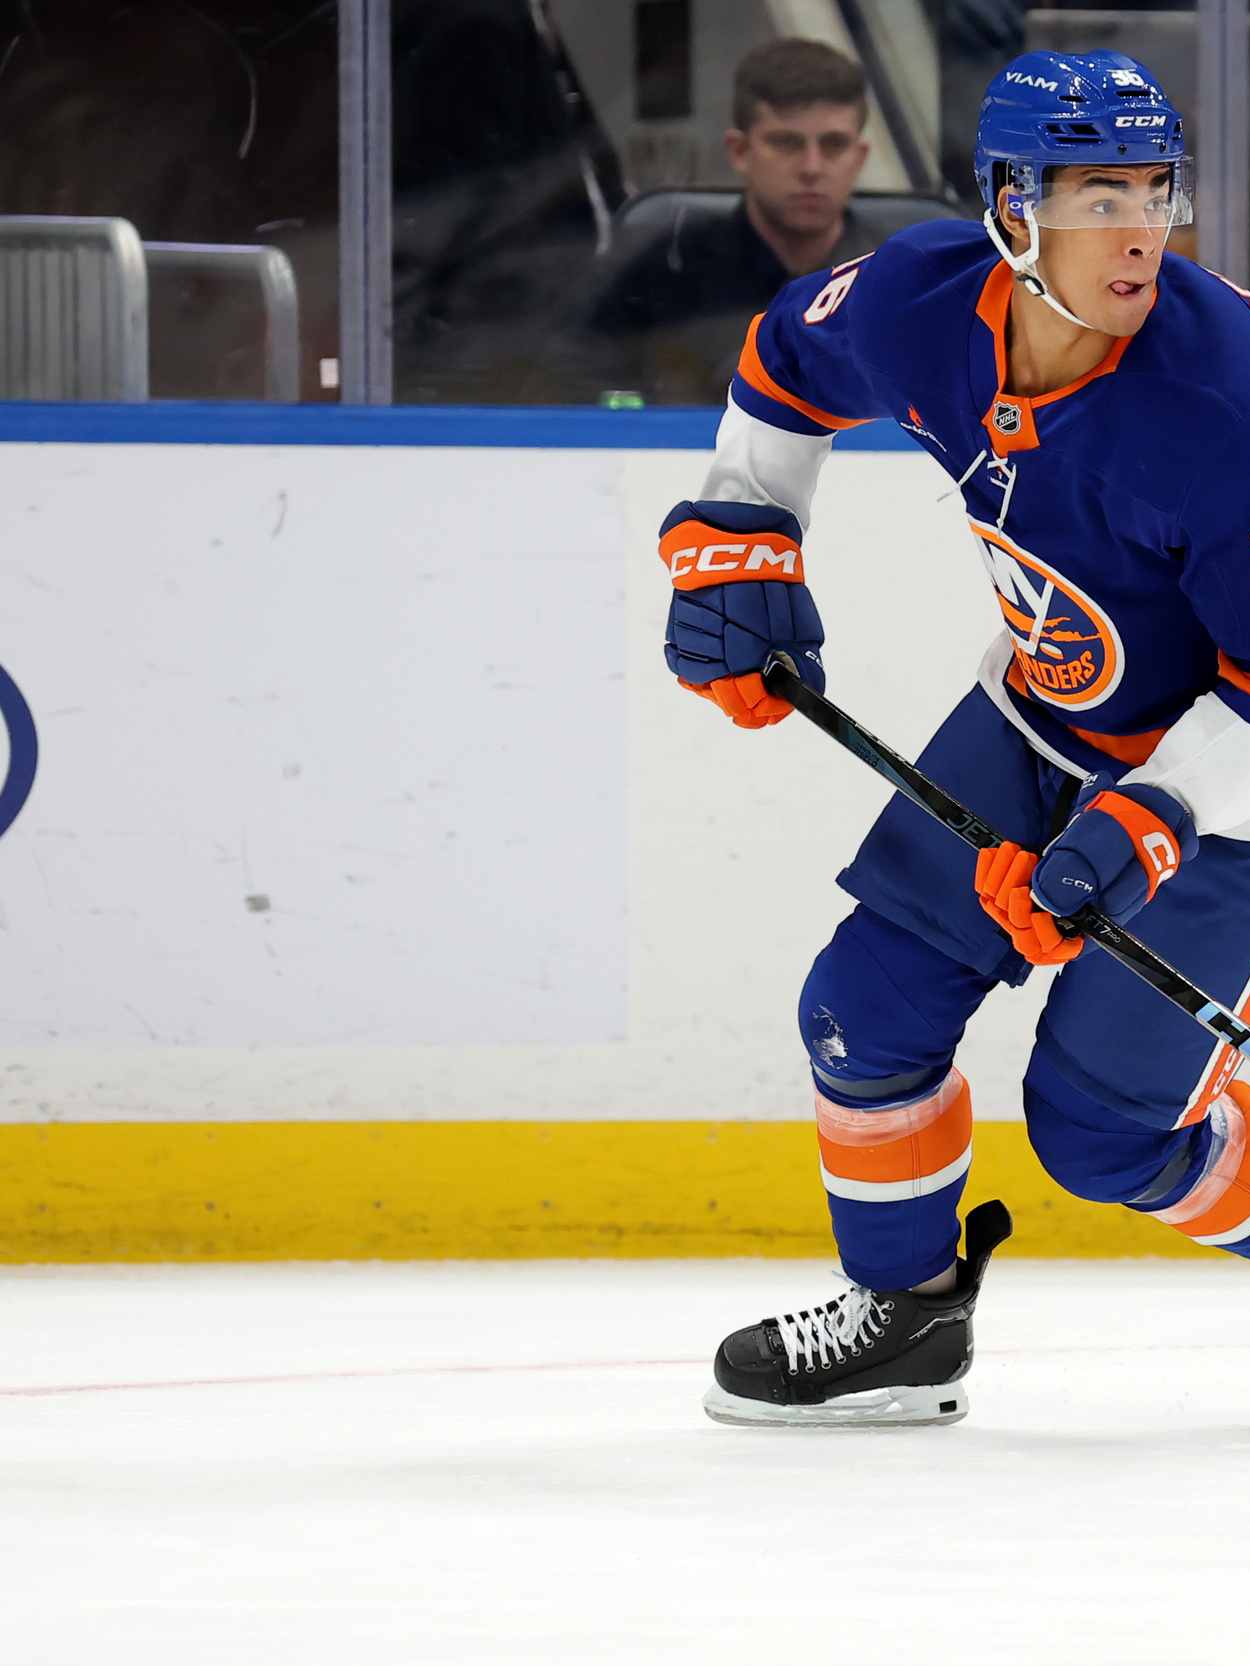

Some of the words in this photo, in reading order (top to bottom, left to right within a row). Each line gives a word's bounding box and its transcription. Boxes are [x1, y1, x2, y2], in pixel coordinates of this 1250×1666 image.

[1005, 71, 1059, 92] VIAM
[1111, 69, 1145, 87] 36
[1114, 115, 1167, 128] CCM
[803, 251, 876, 325] 6
[998, 411, 1017, 427] NHL
[670, 543, 798, 579] CCM
[1061, 877, 1094, 894] CCM
